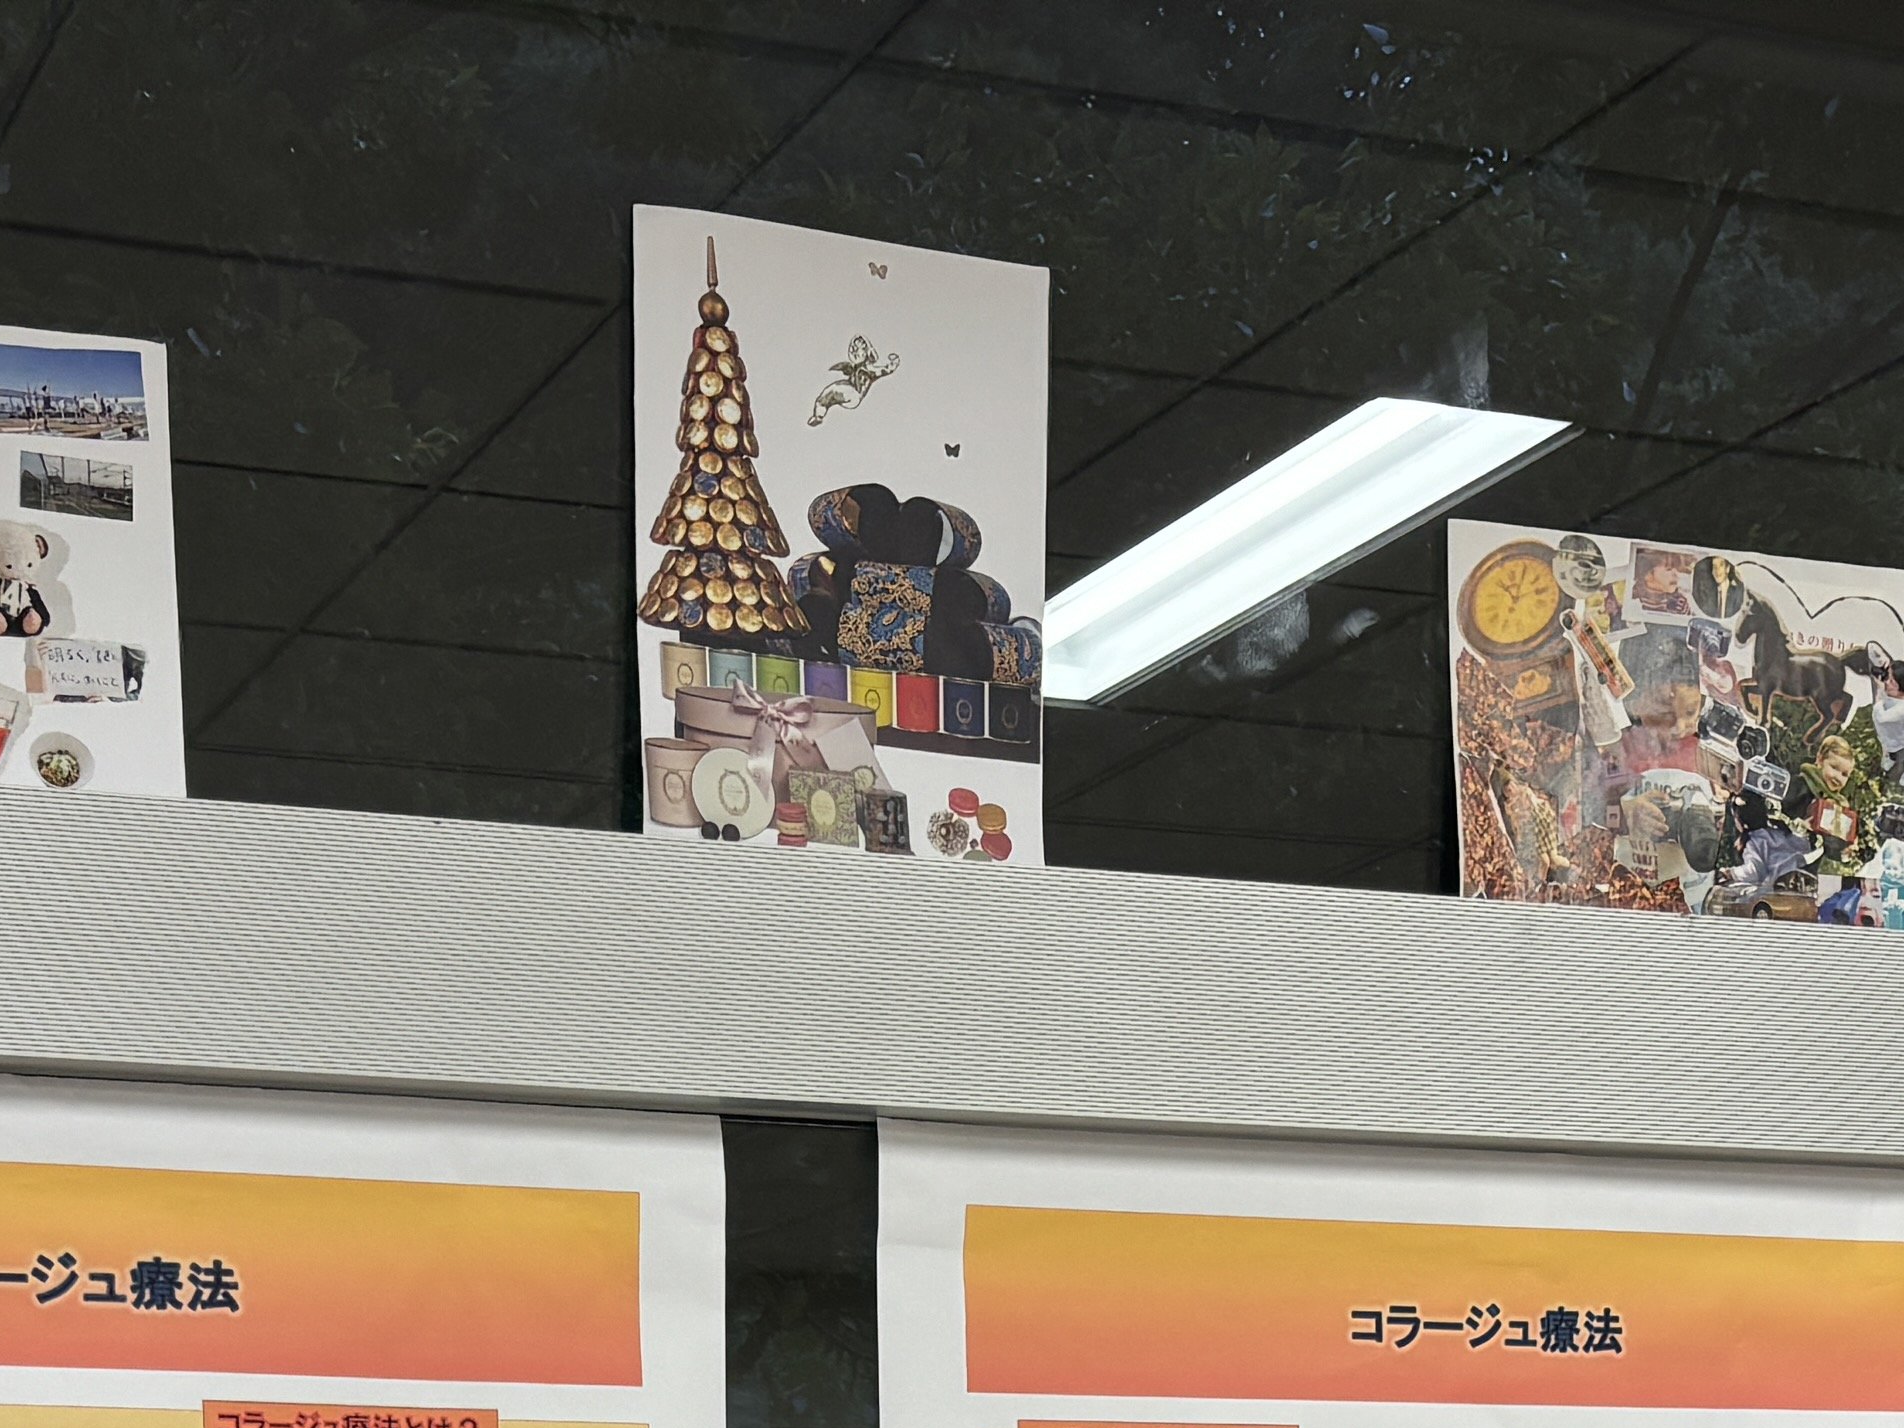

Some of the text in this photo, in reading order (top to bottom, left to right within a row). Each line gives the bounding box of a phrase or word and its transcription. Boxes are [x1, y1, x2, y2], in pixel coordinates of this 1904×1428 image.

[1351, 1304, 1623, 1354] コラージュ療法
